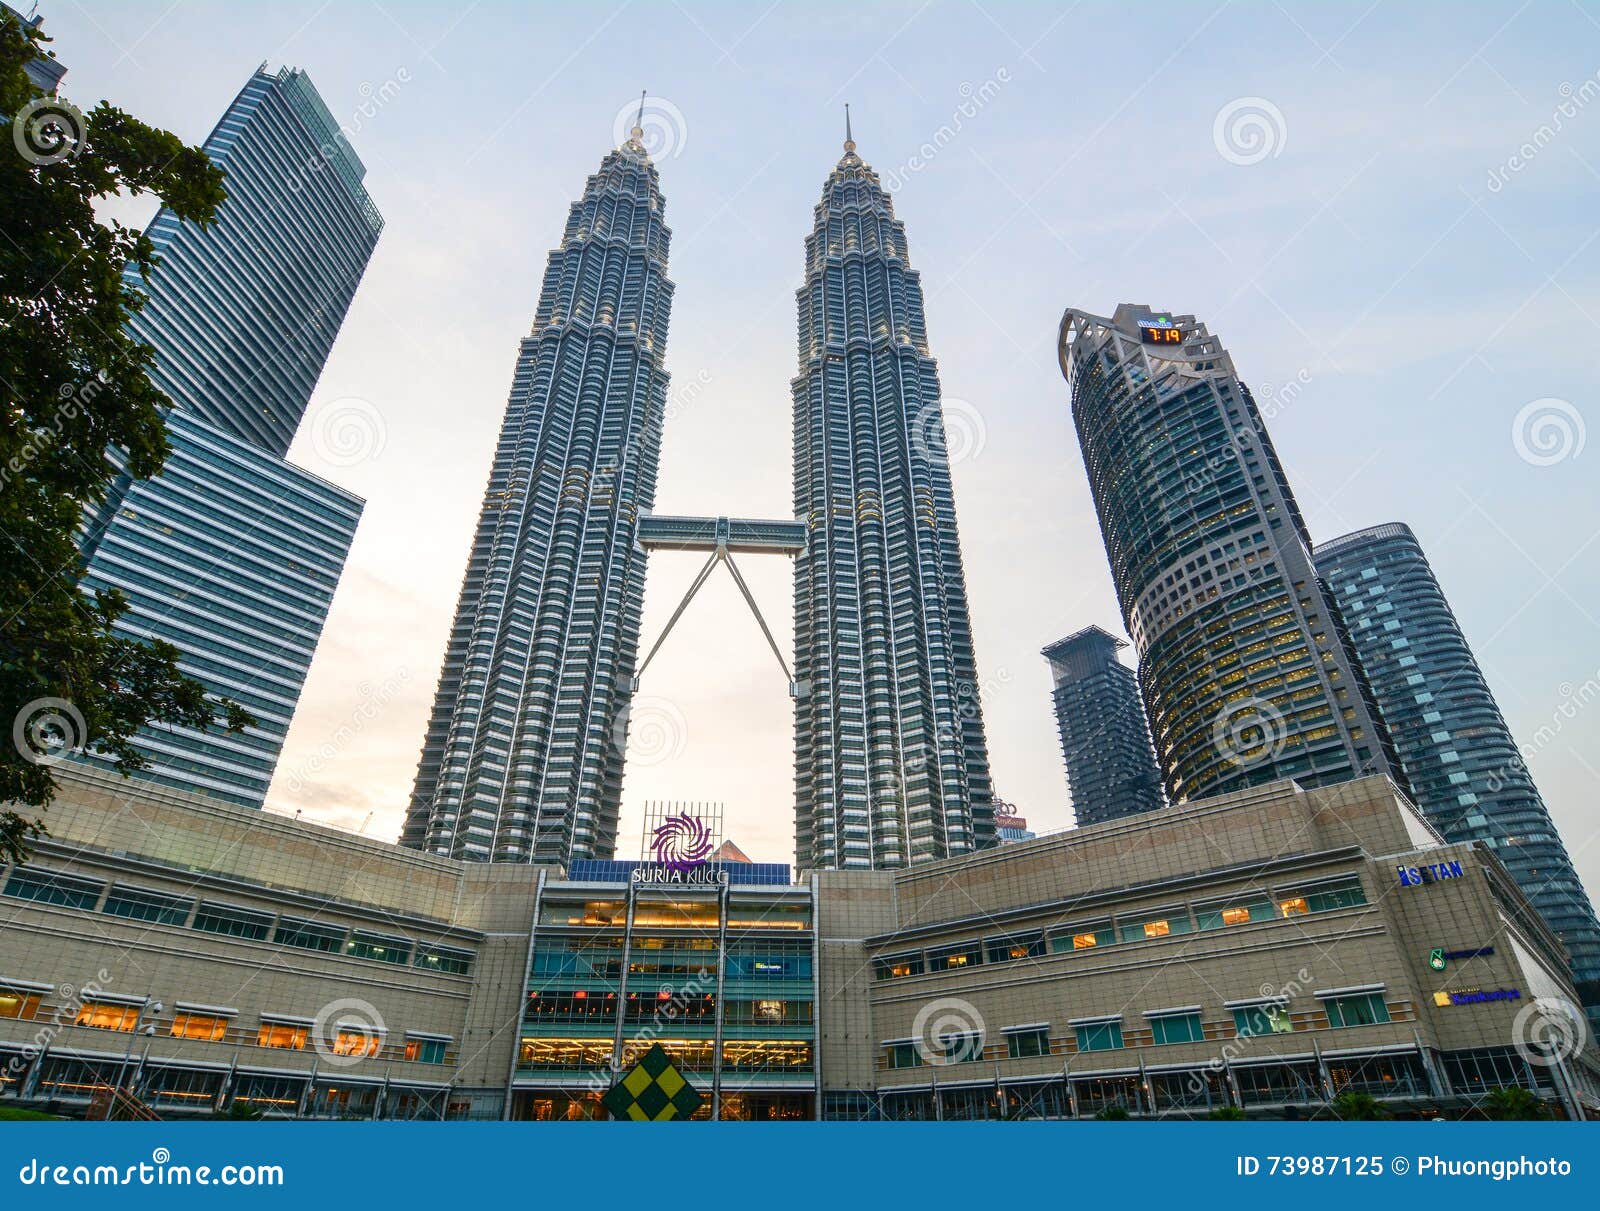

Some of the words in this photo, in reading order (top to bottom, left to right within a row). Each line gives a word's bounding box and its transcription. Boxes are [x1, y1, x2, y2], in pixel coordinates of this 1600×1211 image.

[1149, 328, 1180, 342] 7:19
[632, 868, 682, 883] SURIA
[687, 869, 728, 885] KLCC
